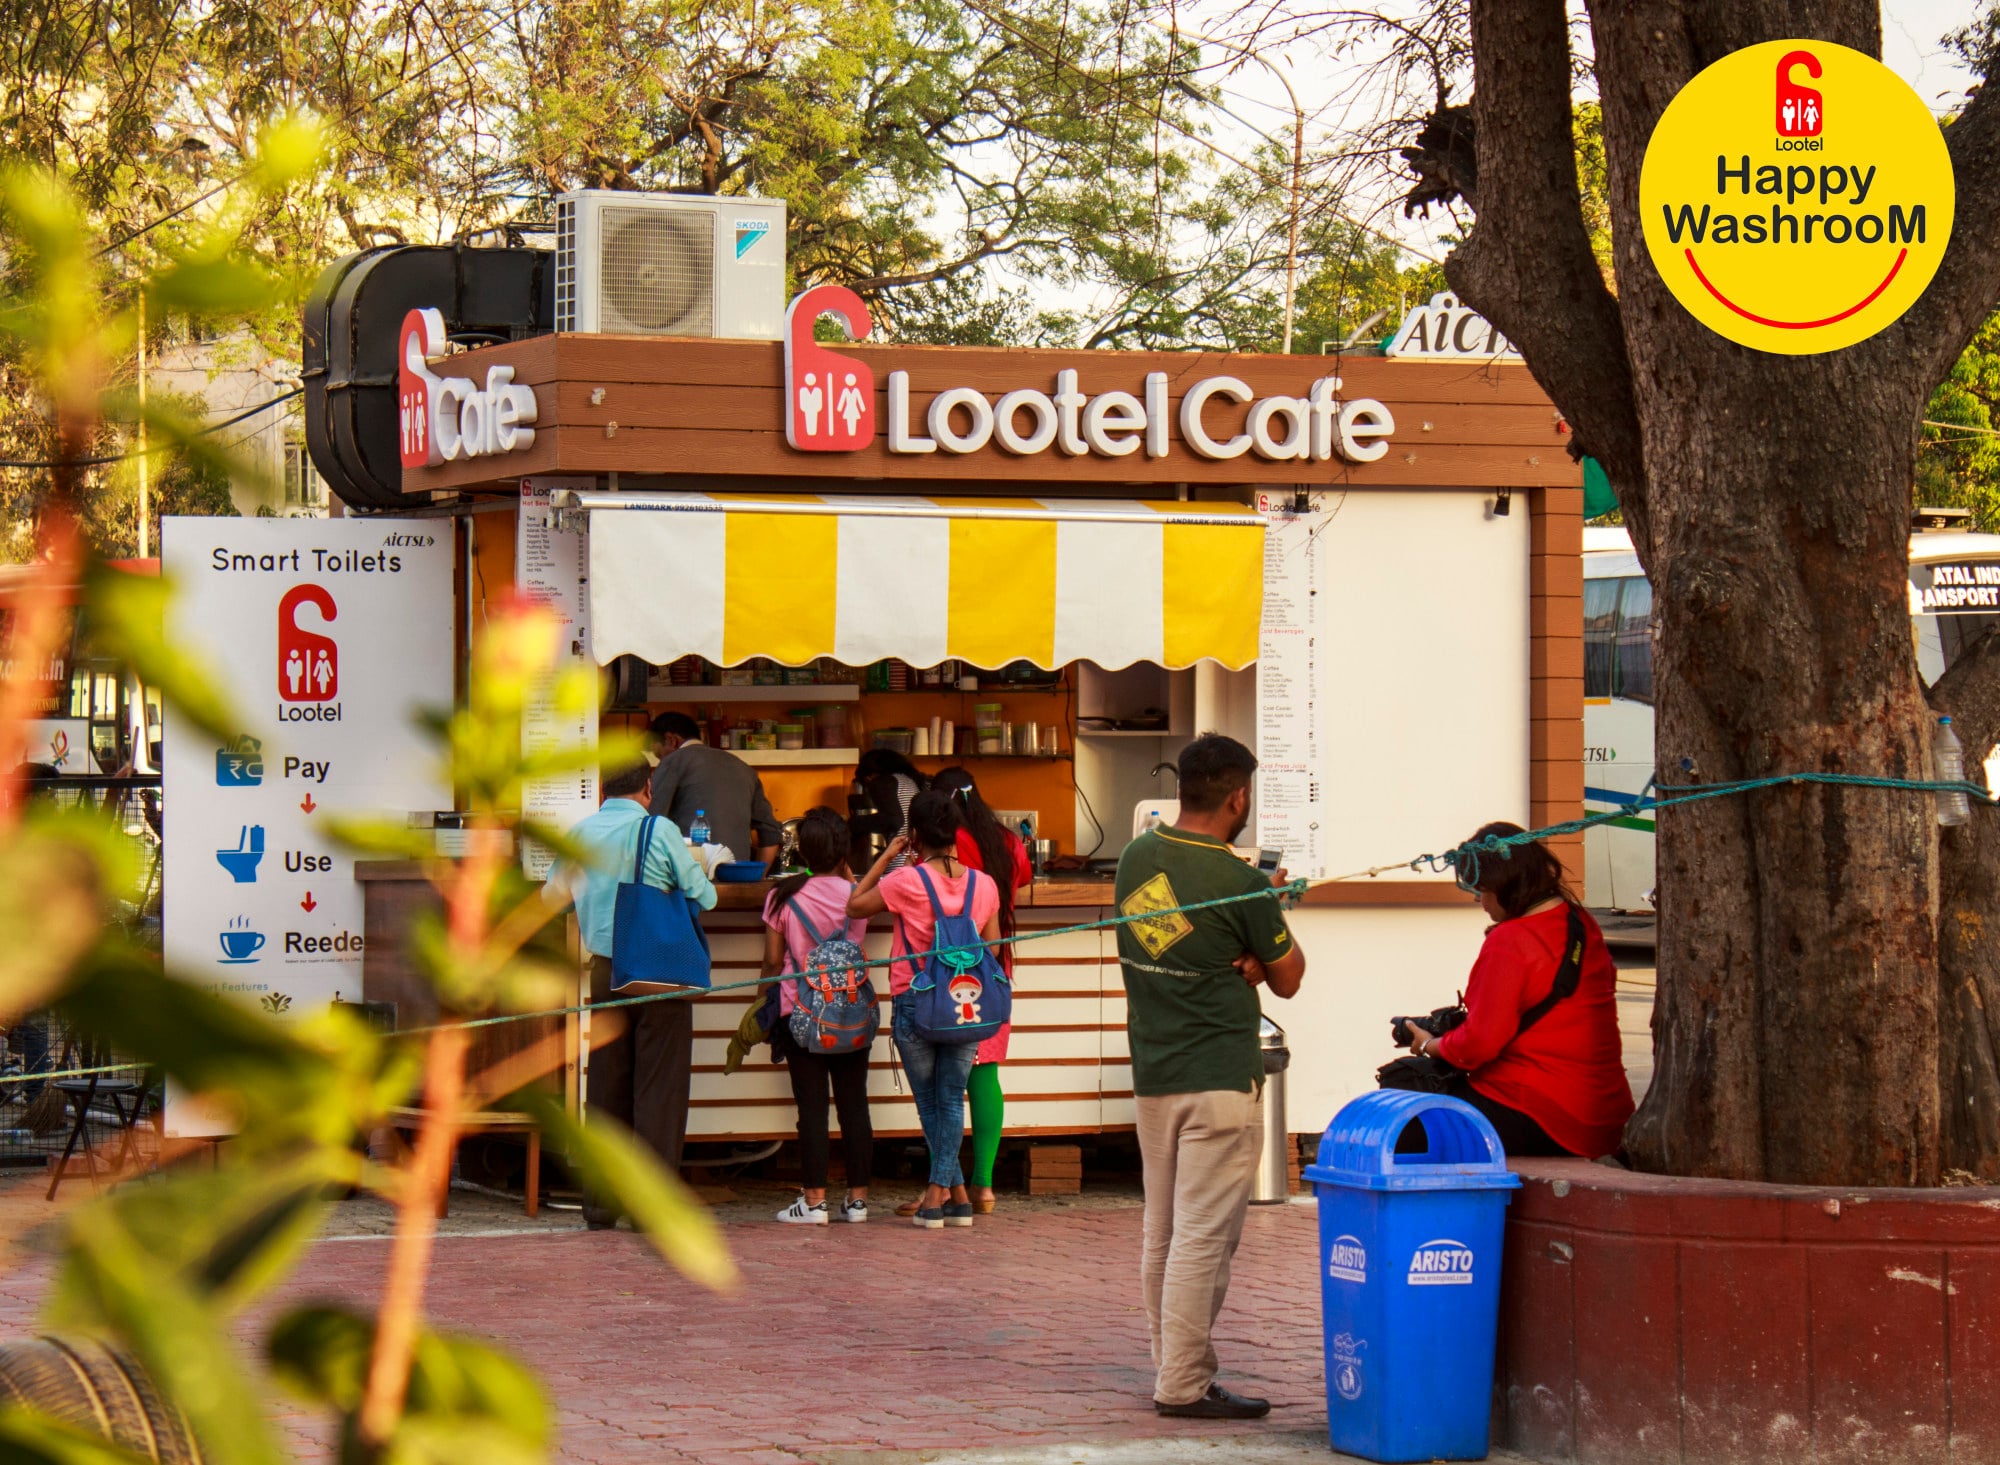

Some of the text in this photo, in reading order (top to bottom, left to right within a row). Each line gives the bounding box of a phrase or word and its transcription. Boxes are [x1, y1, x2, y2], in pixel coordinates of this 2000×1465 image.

[736, 221, 769, 229] SKODA
[434, 365, 538, 460] Cafe
[888, 368, 1395, 462] Lootel Cafe
[1269, 502, 1295, 512] Loote
[212, 548, 401, 572] Smart Toilets
[1933, 566, 1975, 585] ATAL
[278, 702, 341, 722] Lootel
[285, 757, 330, 783] Pay
[285, 851, 332, 872] Use
[285, 931, 364, 954] Reede
[222, 982, 269, 992] Features
[1331, 1244, 1366, 1269] ARISTO
[1410, 1250, 1474, 1272] ARISTO
